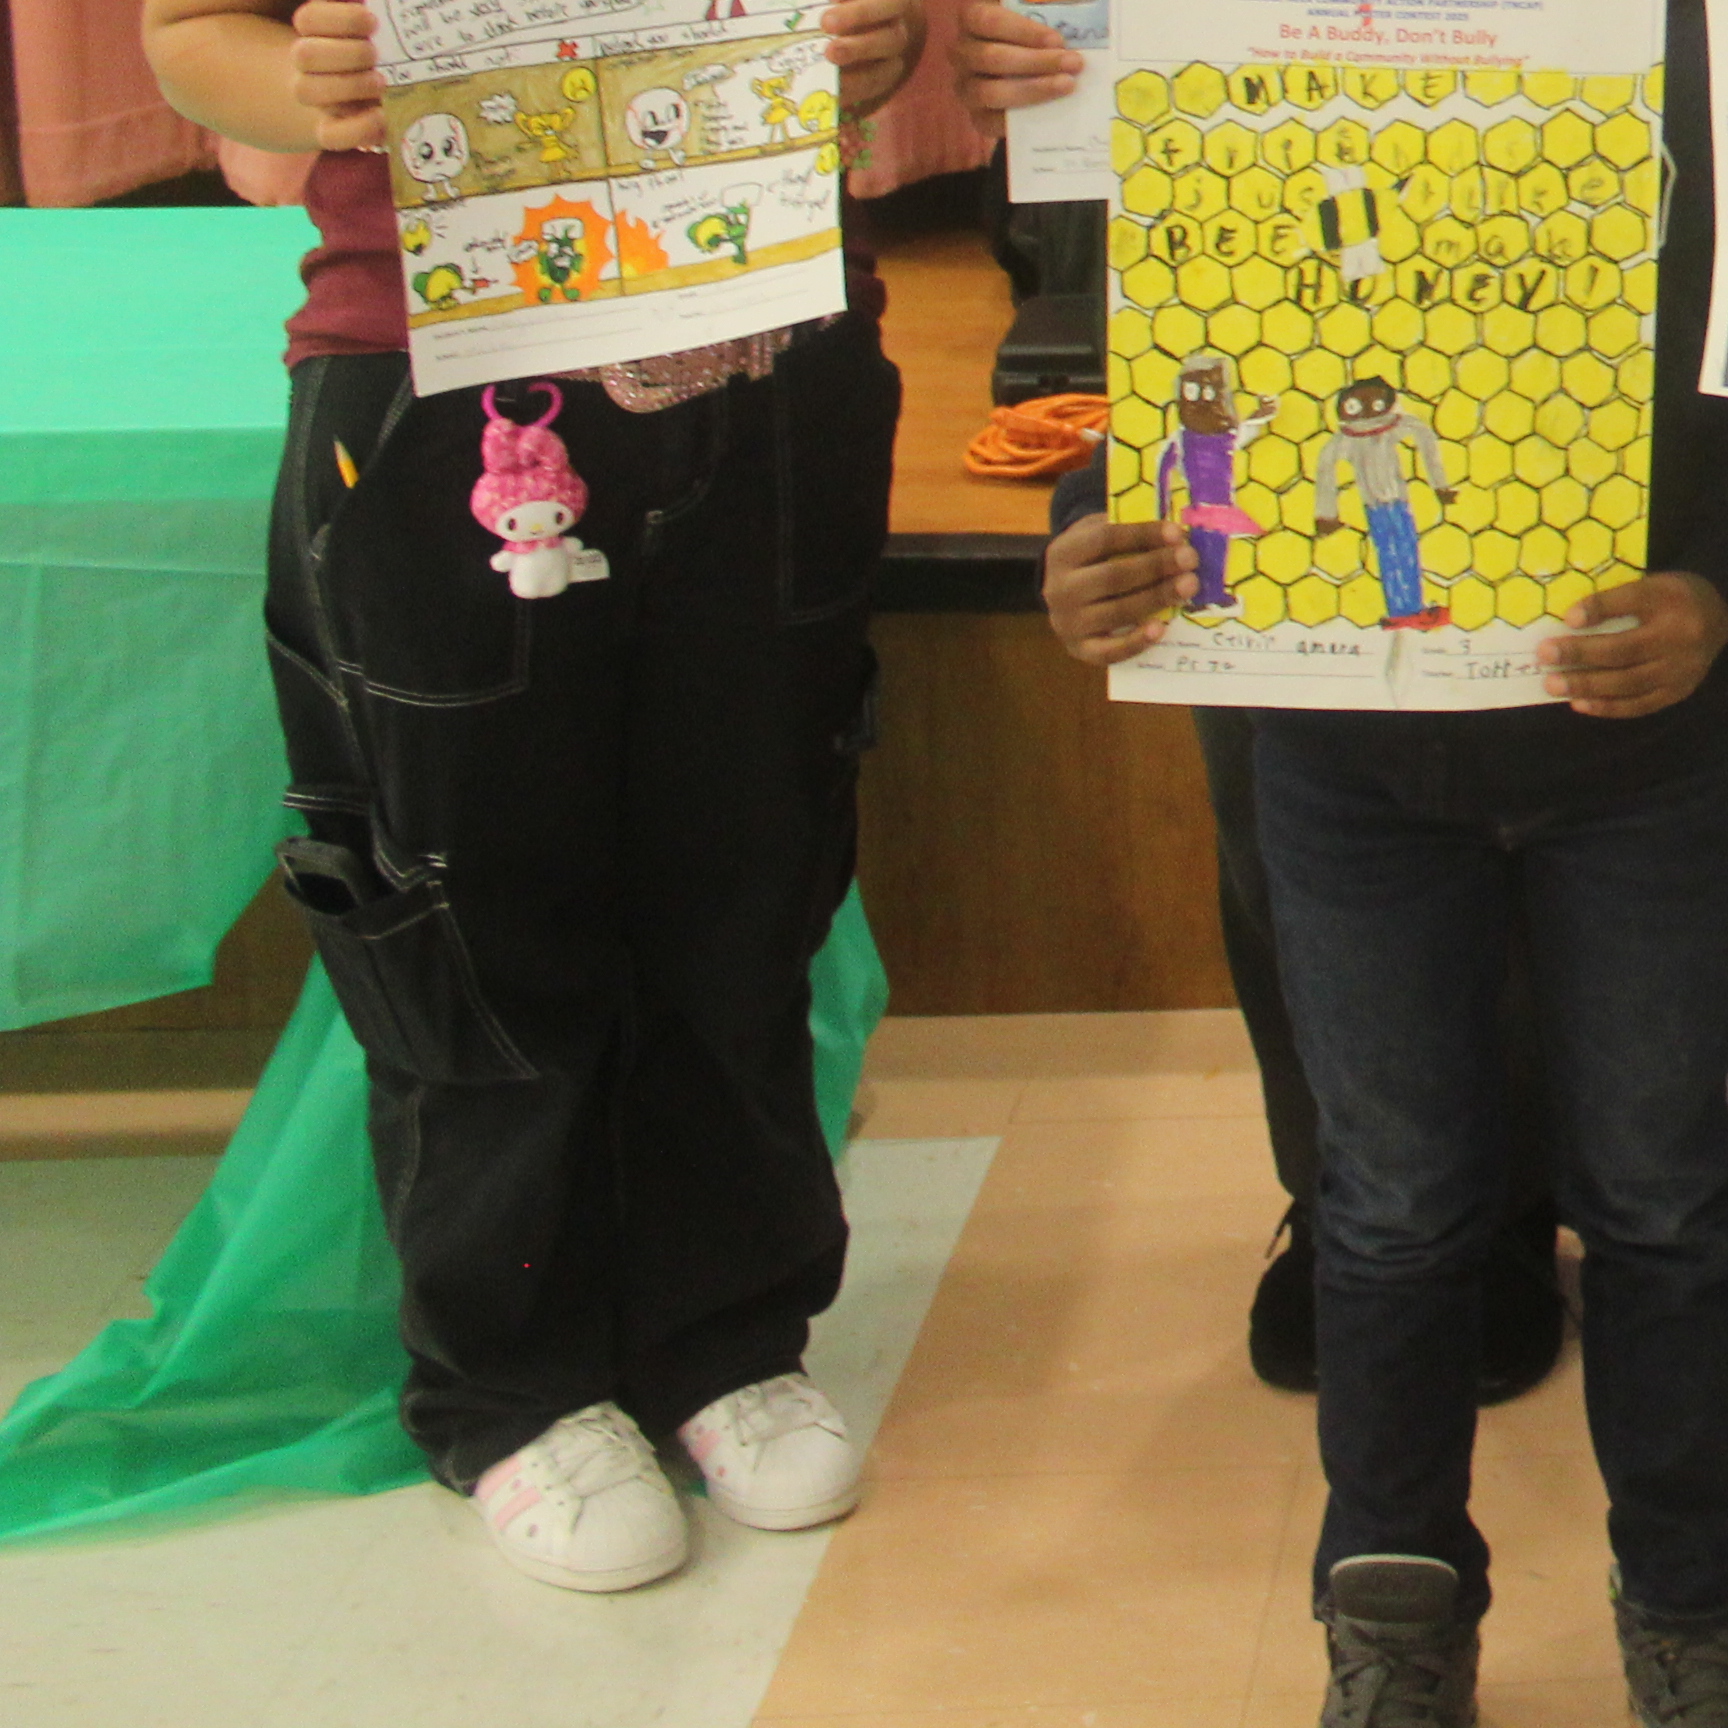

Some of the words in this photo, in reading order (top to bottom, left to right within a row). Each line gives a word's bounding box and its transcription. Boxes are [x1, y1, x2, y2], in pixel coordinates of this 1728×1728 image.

[1279, 23, 1302, 39] Be
[1309, 25, 1320, 38] A
[1452, 29, 1497, 46] Bully
[1243, 69, 1441, 106] MAKE
[1298, 262, 1599, 309] HONEY!
